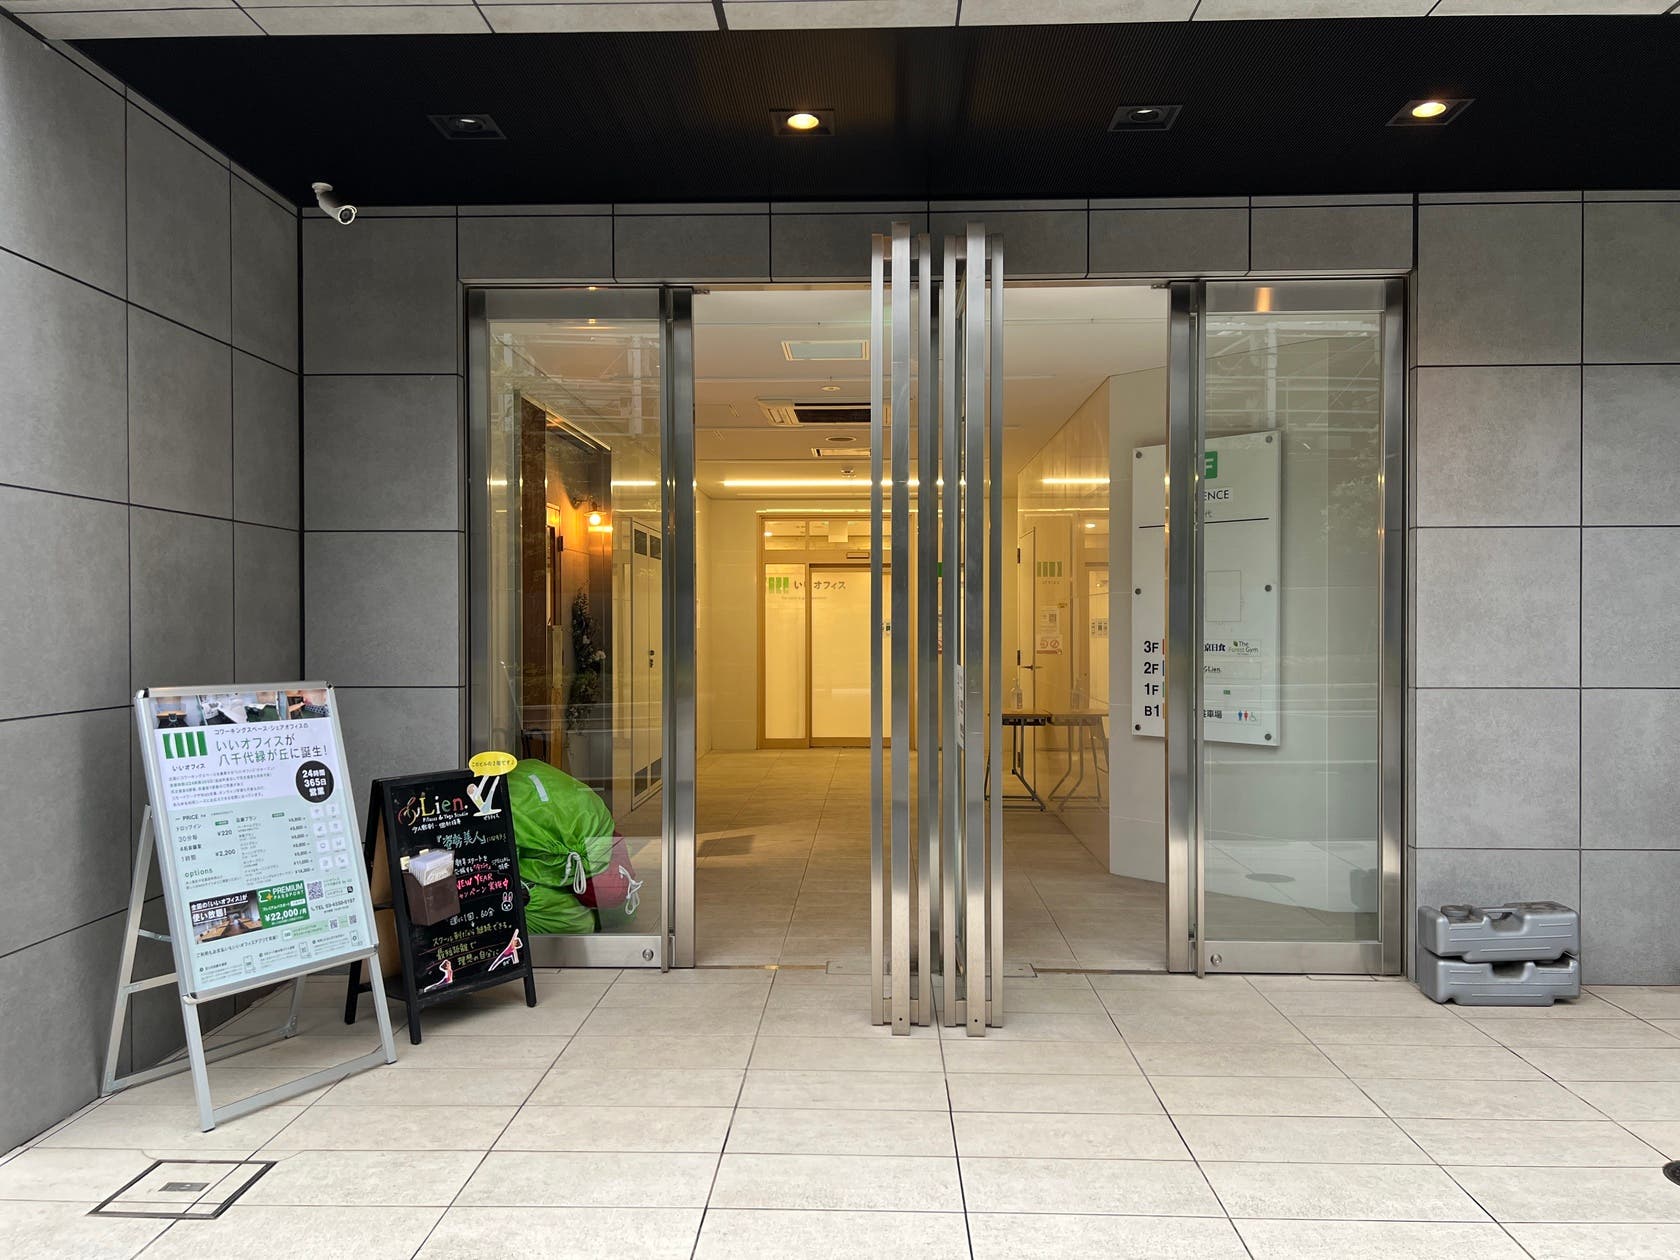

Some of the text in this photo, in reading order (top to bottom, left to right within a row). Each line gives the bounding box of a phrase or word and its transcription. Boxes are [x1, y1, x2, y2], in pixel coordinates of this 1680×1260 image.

[794, 580, 846, 590] いオフィス
[1143, 640, 1159, 653] 3F
[1238, 640, 1249, 648] The
[1143, 662, 1159, 675] 2F
[1144, 683, 1159, 696] 1F
[1144, 704, 1160, 717] B1
[216, 734, 295, 752] いいオフィスが
[172, 763, 206, 772] いいオフィス
[302, 769, 326, 779] 24時間
[304, 778, 328, 788] 365日
[308, 787, 326, 797] 営業
[184, 868, 214, 878] options
[474, 873, 493, 886] YEAR
[272, 883, 304, 895] PREMIUM
[273, 890, 305, 900] PASSPORT
[264, 908, 299, 922] ¥22,000
